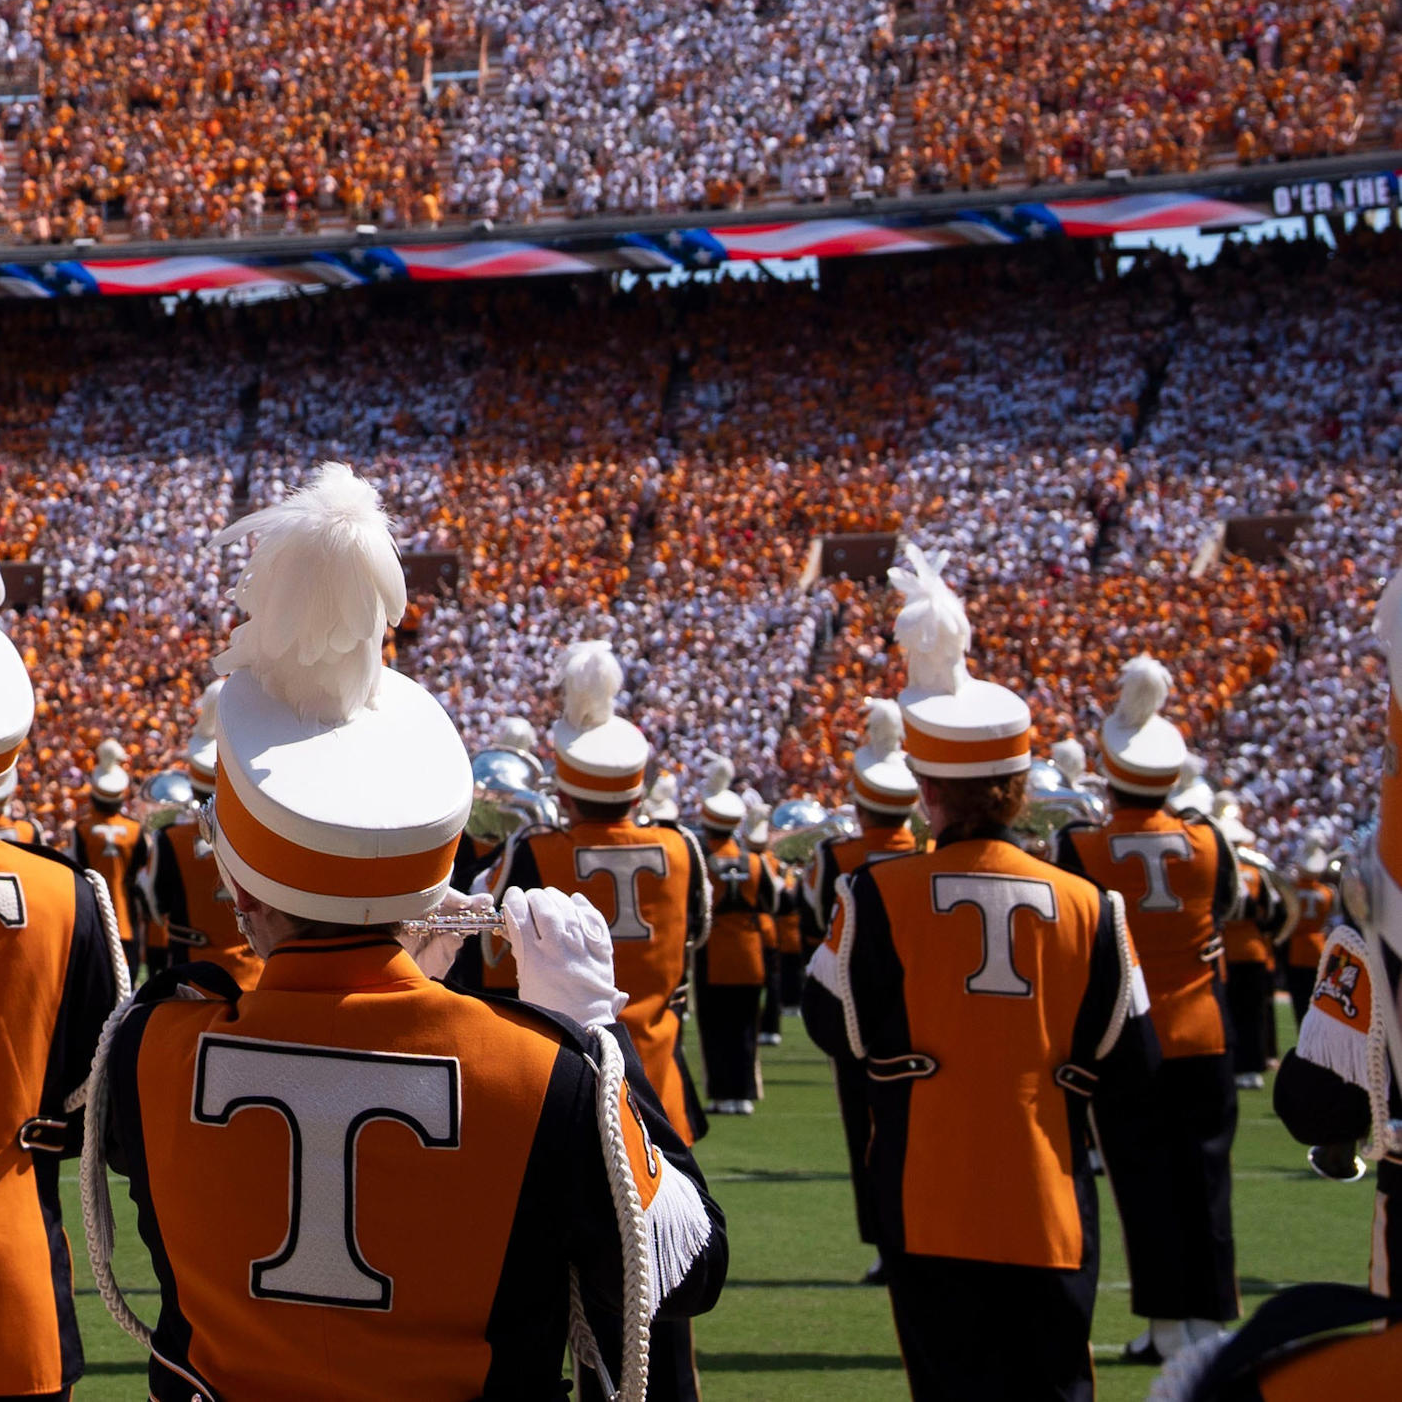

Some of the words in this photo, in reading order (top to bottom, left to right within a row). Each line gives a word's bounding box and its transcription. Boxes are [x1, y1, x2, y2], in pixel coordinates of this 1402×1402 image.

[1273, 183, 1333, 215] O'ER
[1339, 175, 1390, 208] THE
[574, 843, 669, 942] T
[1108, 831, 1194, 913] T
[929, 871, 1059, 998] T
[191, 1032, 462, 1312] T
